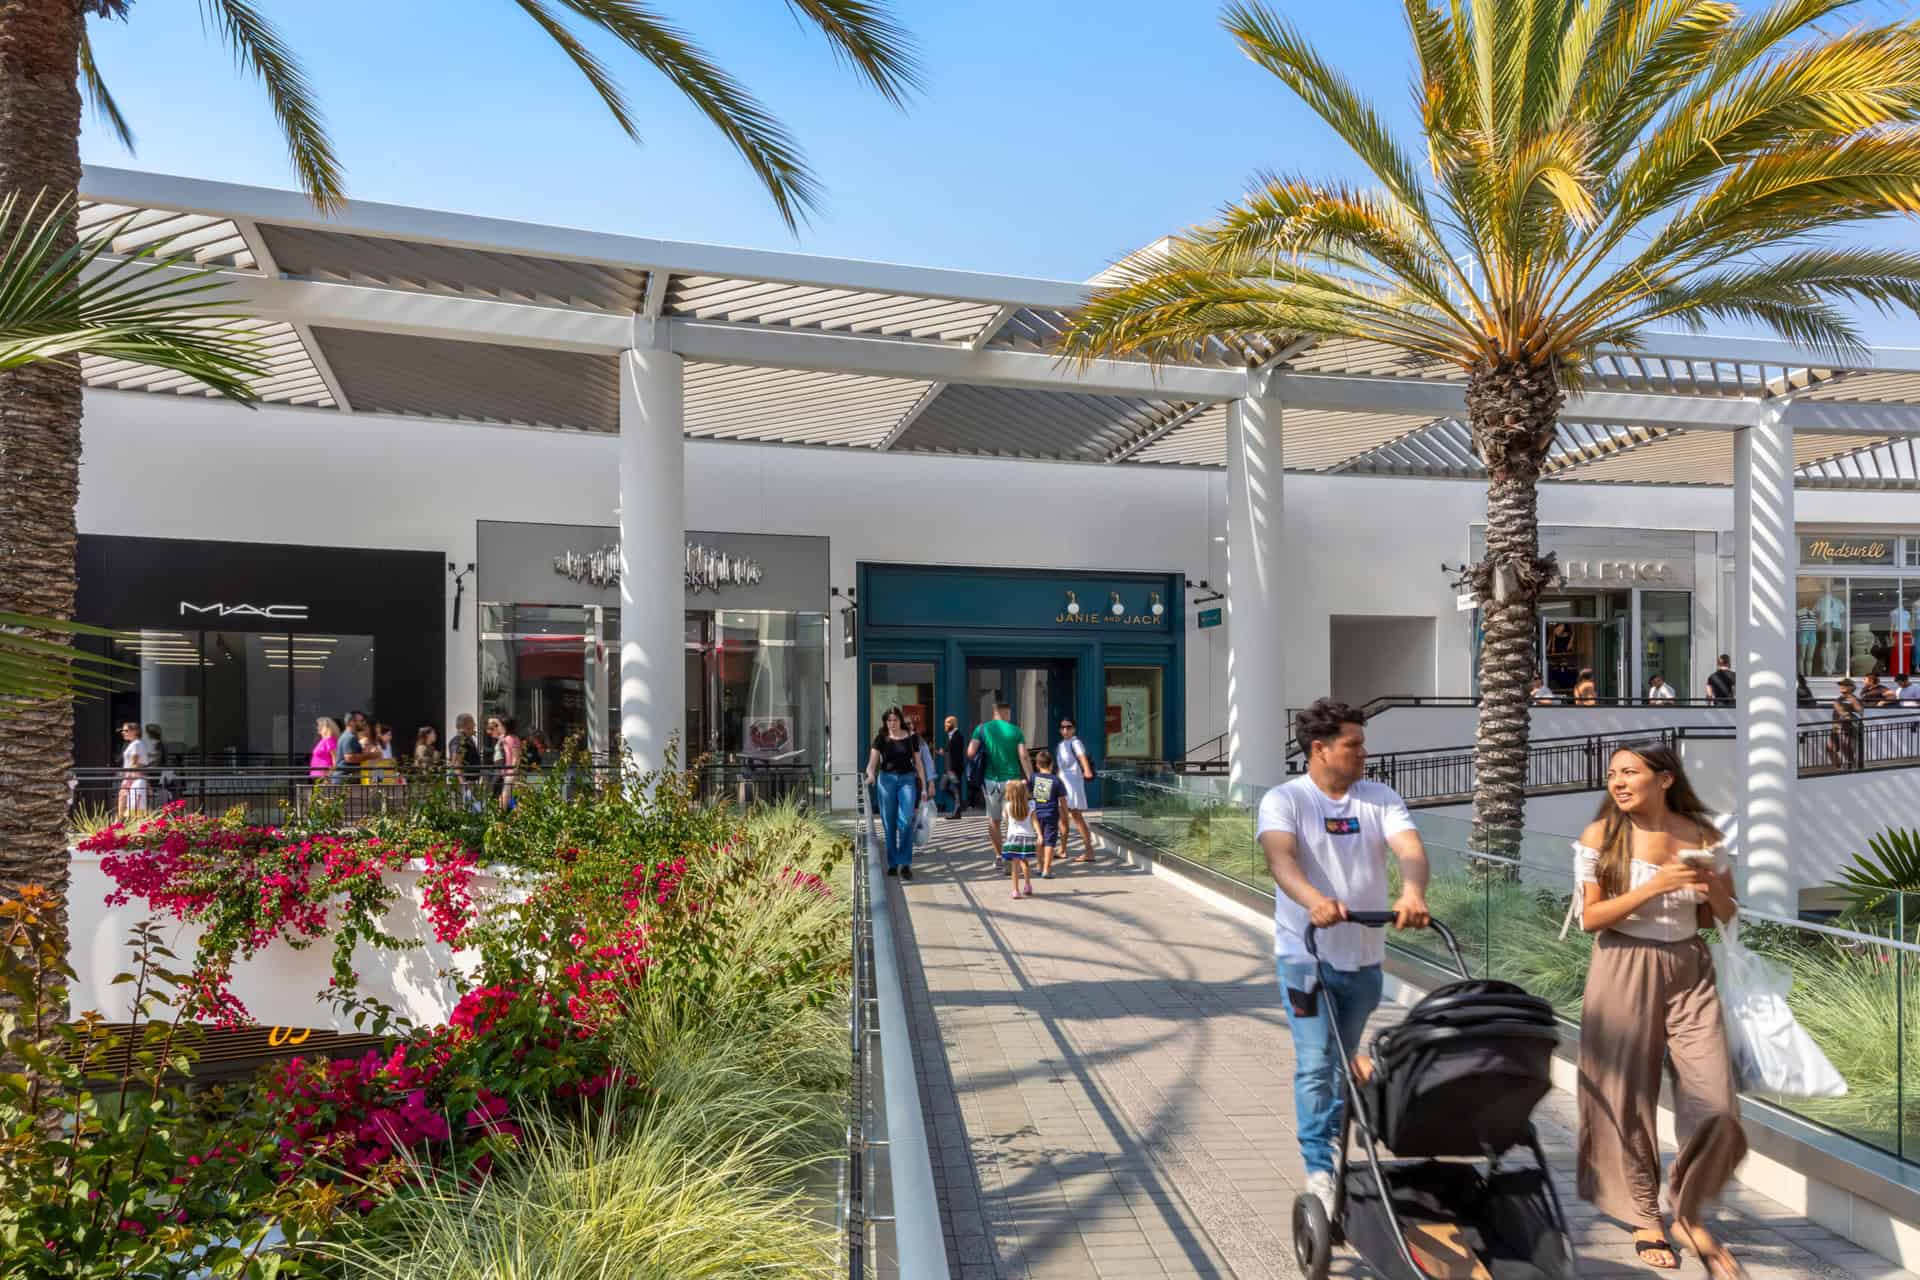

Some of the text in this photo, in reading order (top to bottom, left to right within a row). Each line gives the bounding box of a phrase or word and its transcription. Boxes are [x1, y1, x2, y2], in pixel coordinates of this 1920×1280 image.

[1809, 541, 1886, 560] Madewell
[1055, 612, 1099, 624] JANIE
[1123, 614, 1161, 625] JACK
